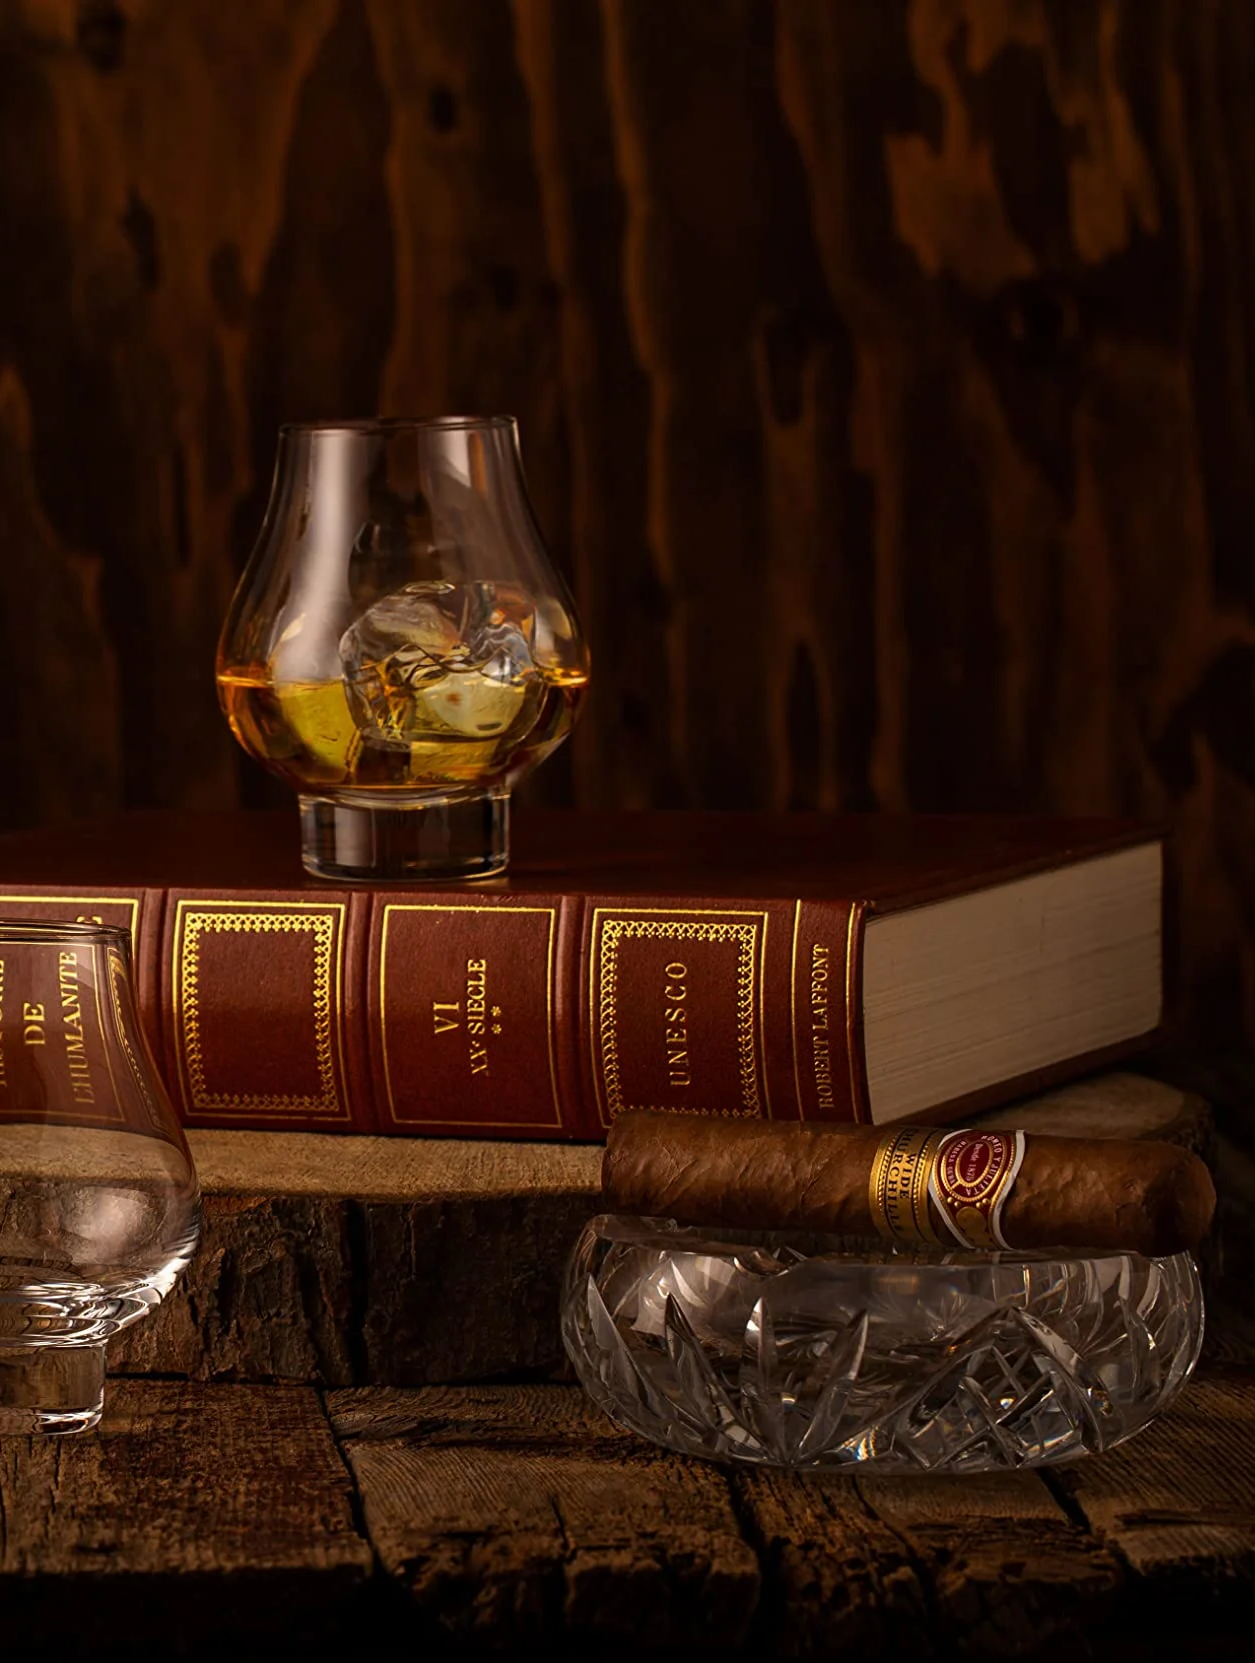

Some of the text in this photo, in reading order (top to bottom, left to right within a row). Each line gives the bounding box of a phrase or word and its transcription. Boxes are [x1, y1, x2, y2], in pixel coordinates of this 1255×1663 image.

[23, 1002, 45, 1046] DE
[432, 1001, 460, 1034] VI
[665, 961, 691, 1087] UNESCO
[811, 944, 835, 1109] ROBERT LAFFONT
[969, 1143, 984, 1162] Desde
[981, 1135, 1003, 1153] ROMEO
[899, 1153, 917, 1199] WIDE
[965, 1163, 998, 1197] JULIETA
